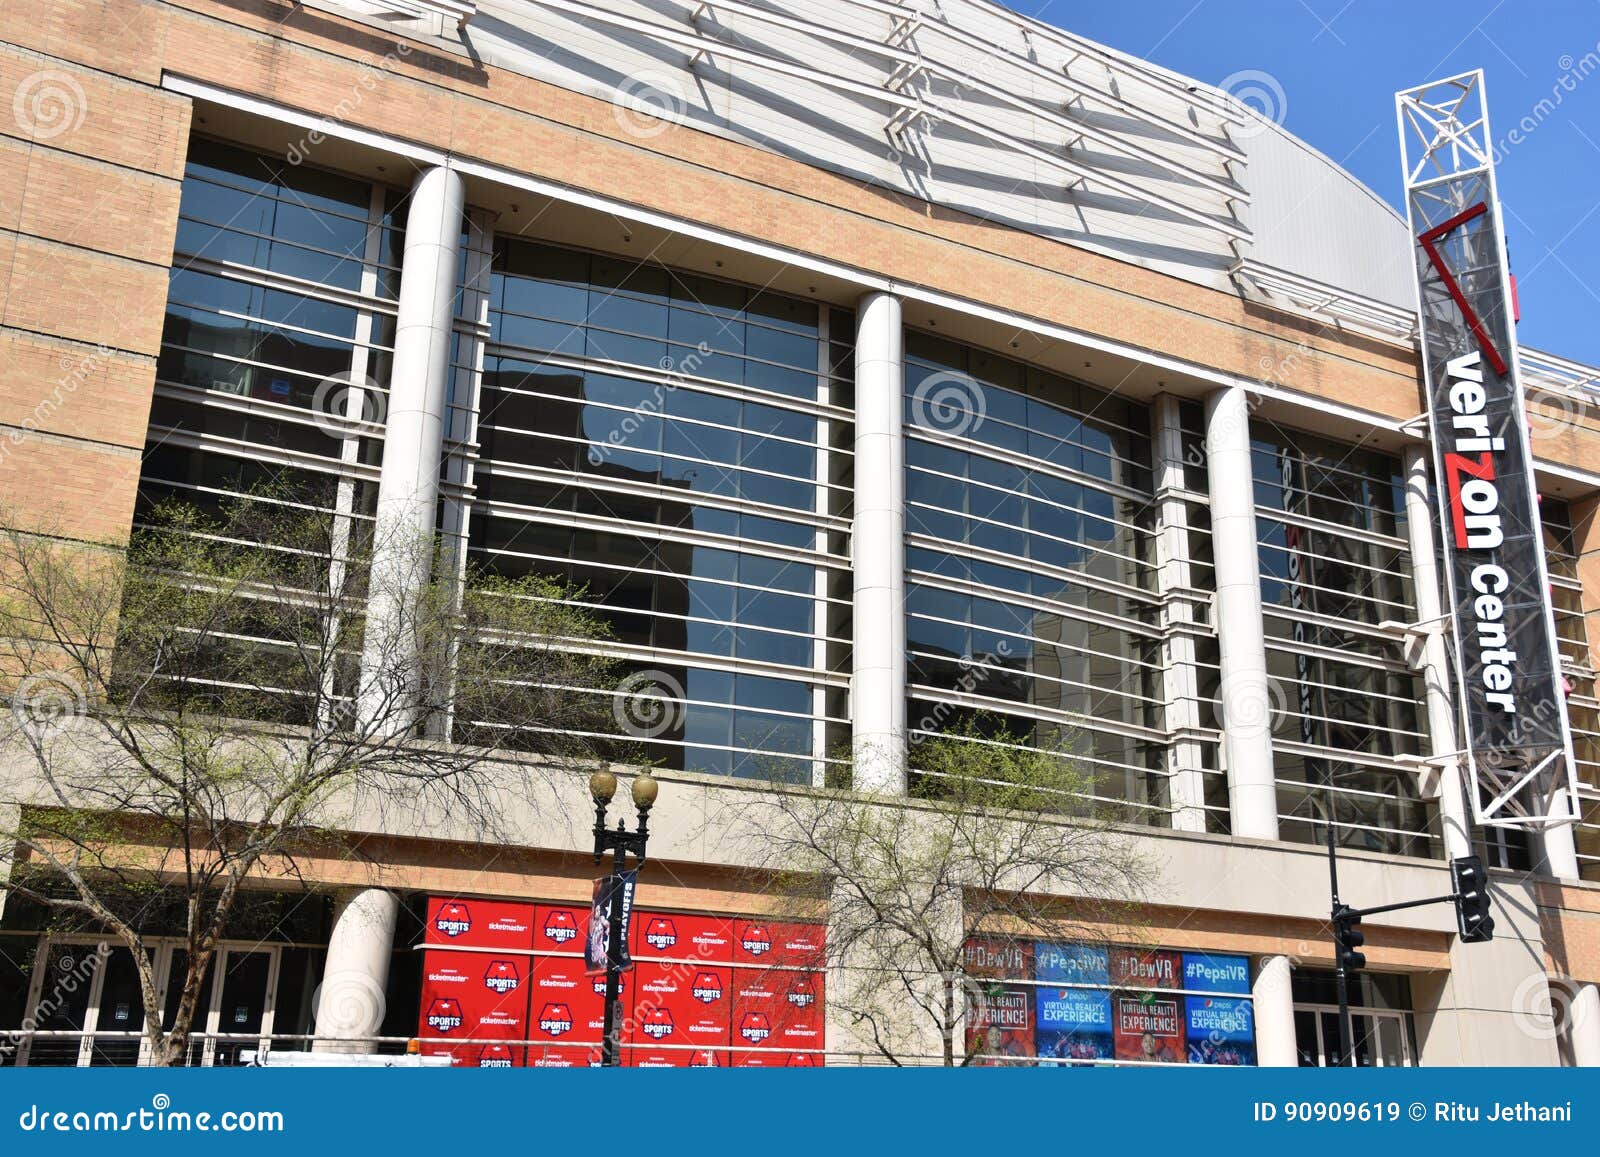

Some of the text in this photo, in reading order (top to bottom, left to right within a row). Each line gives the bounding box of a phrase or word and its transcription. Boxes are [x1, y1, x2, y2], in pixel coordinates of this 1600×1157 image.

[1444, 351, 1517, 713] verizon center
[620, 882, 633, 941] PLAYOFFS
[438, 921, 469, 931] SPORTS
[546, 928, 575, 938] SPORTS
[647, 935, 675, 944] SPORTS
[743, 941, 769, 951] SPORTS
[1120, 957, 1173, 979] #DewVR
[1186, 962, 1246, 983] #PepsiVR
[487, 977, 517, 988] SPORTS
[693, 988, 721, 998] SPORTS
[1043, 1001, 1105, 1012] VIRTUAL REALITY
[1122, 1003, 1175, 1016] VIRTUAL REALITY
[1043, 1010, 1105, 1023] EXPERIENCE
[1191, 1009, 1219, 1018] VIRTUAL
[428, 1016, 460, 1026] SPORTS
[540, 1021, 571, 1031] SPORTS
[1123, 1016, 1176, 1032] EXPERIENCE
[1191, 1017, 1247, 1031] EXPERIENCE
[644, 1024, 672, 1033] SPORTS
[742, 1029, 769, 1037] SPORTS
